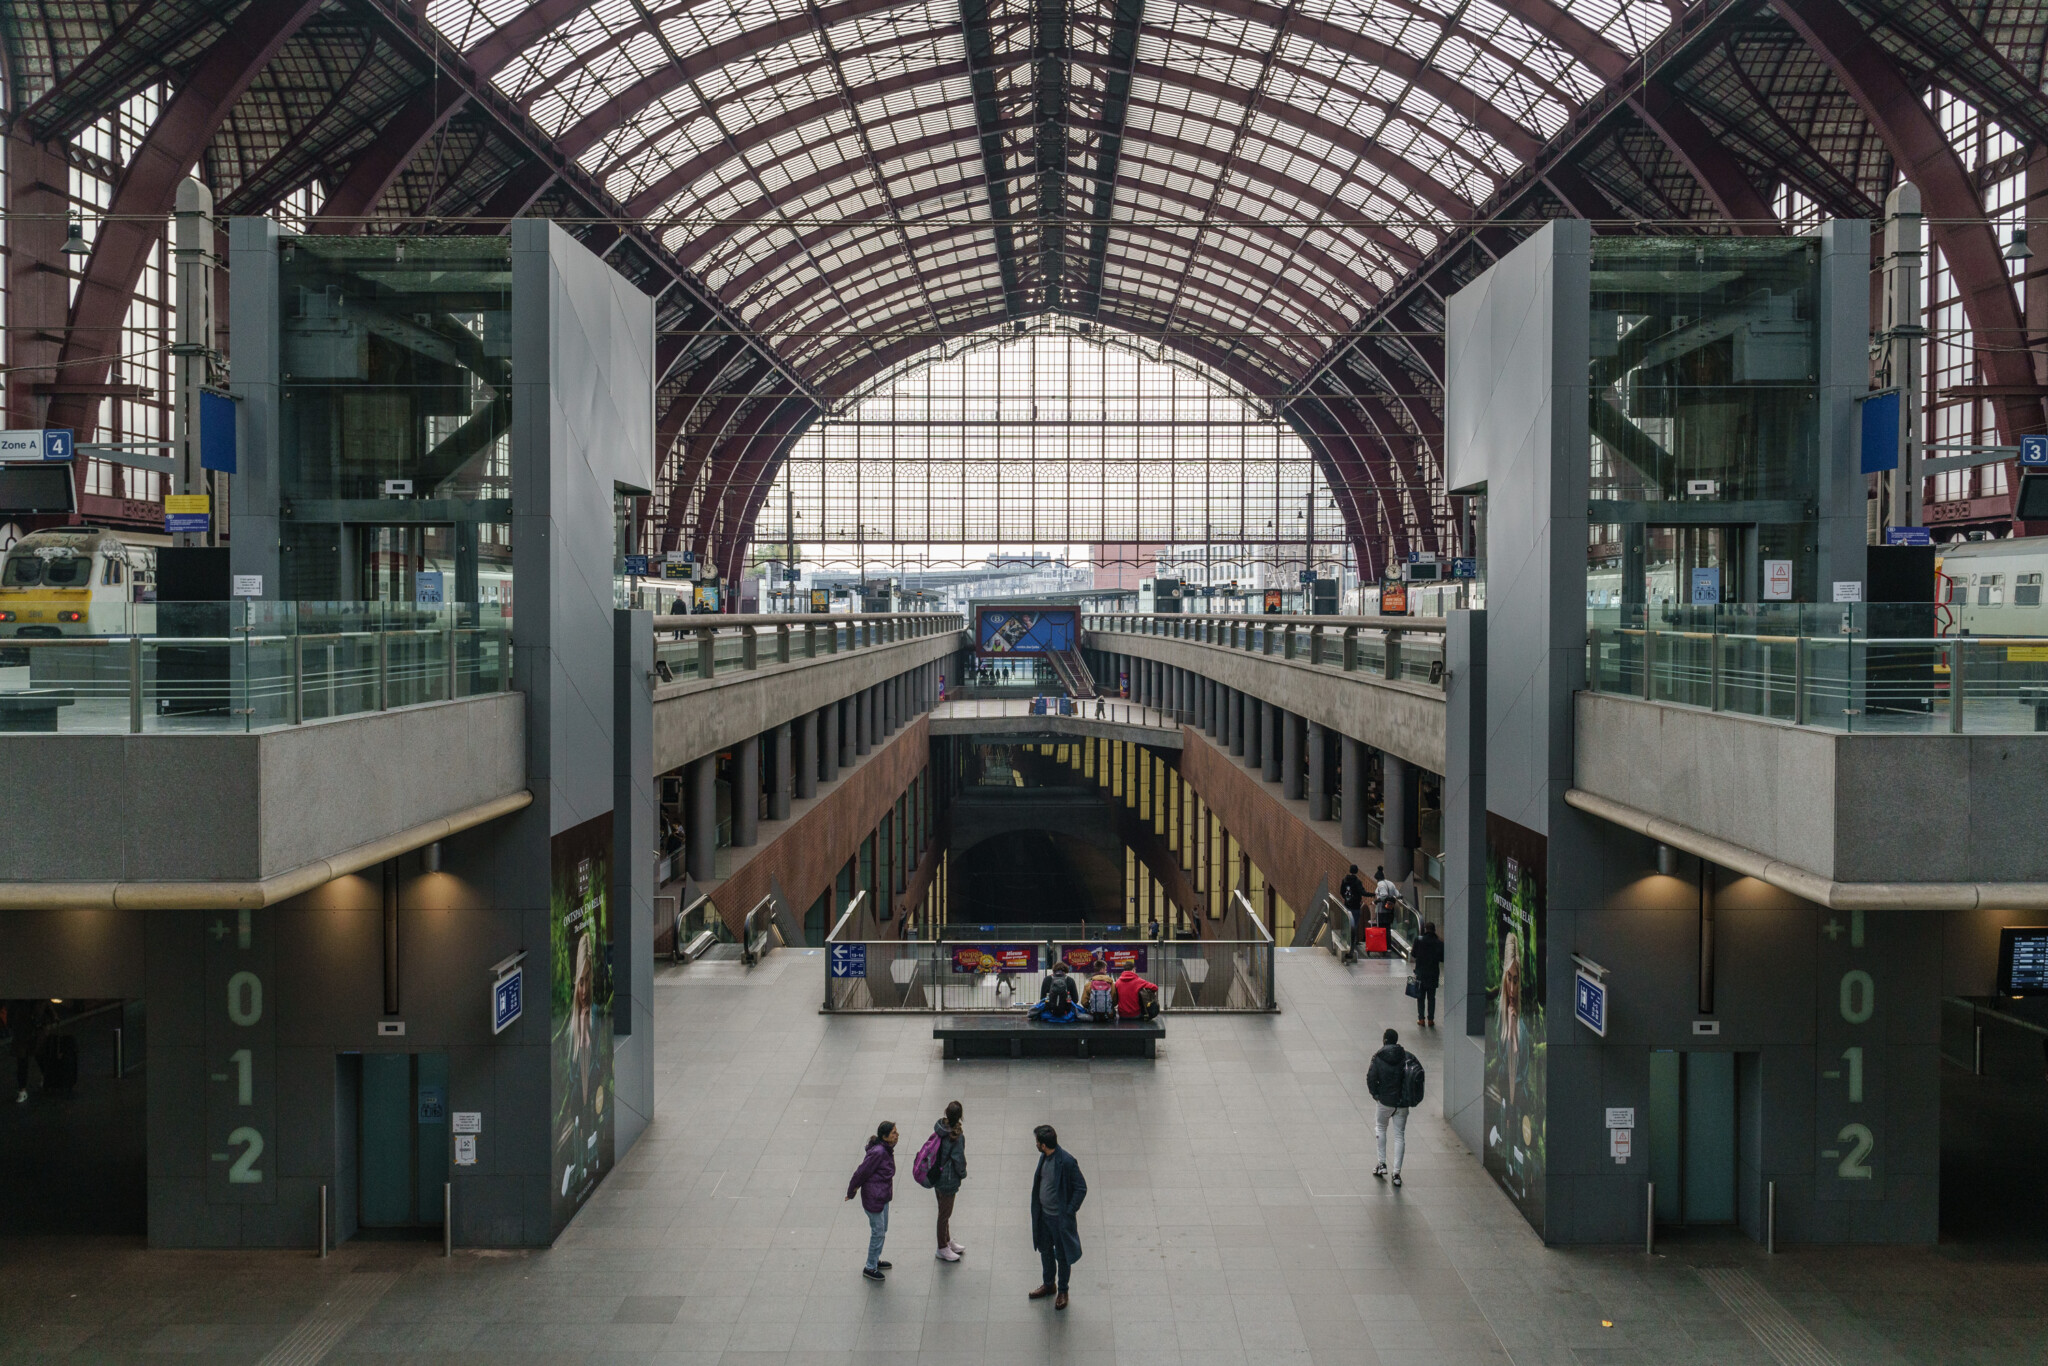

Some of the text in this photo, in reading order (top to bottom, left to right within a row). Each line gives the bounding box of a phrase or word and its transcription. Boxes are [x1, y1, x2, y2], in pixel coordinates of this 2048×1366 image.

[1, 440, 37, 449] Zone A
[52, 438, 64, 454] 4
[2030, 444, 2041, 460] 3
[1971, 573, 1977, 586] 2
[563, 905, 584, 927] ONTSPAN
[584, 901, 591, 914] EN
[1493, 892, 1513, 912] ONTSPAN
[1512, 904, 1519, 917] EN
[1520, 908, 1534, 927] RELAX
[227, 970, 263, 1027] 0
[1840, 969, 1875, 1025] 0
[211, 1048, 253, 1106] -1
[1822, 1046, 1863, 1103] -1
[211, 1126, 264, 1184] -2
[1821, 1122, 1874, 1180] -2
